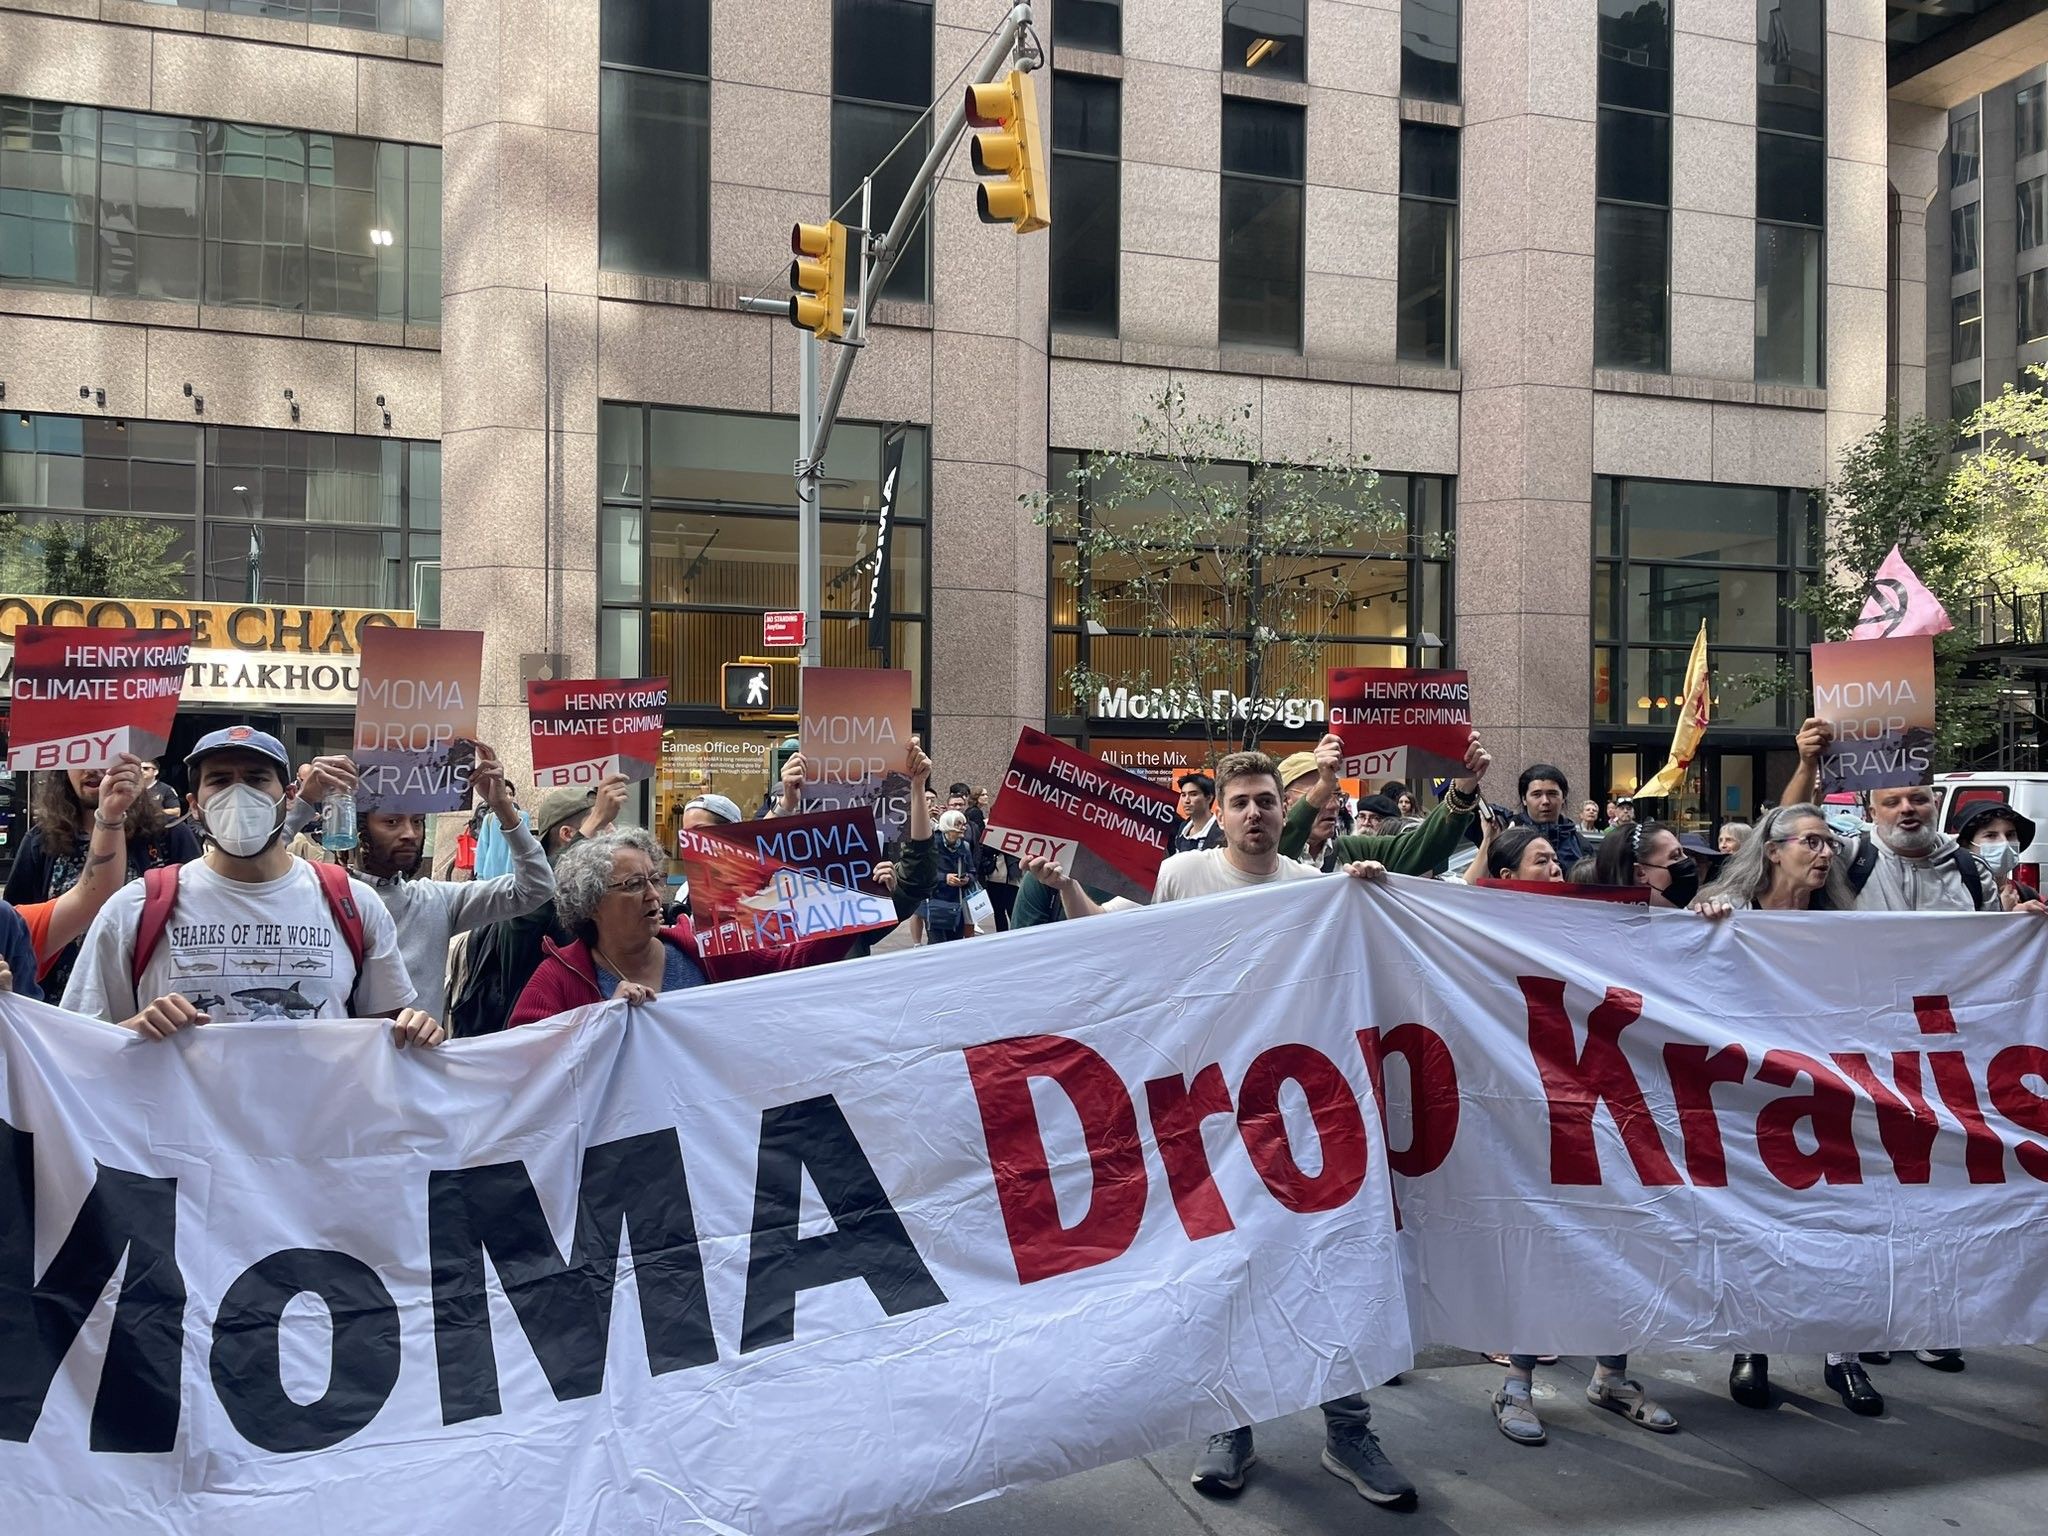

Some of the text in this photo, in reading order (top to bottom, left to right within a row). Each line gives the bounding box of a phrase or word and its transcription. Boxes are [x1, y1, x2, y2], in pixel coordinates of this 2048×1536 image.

[766, 615, 798, 623] NO STANDING
[65, 644, 190, 668] HENRY KRAVIS
[14, 674, 183, 701] CLIMATE CRIMINAL
[361, 678, 464, 710] MOMA
[565, 689, 668, 711] HENRY KRAVIS
[1364, 682, 1469, 700] HENRY KRAVIS
[1816, 679, 1917, 710] MOMA
[1098, 687, 1325, 729] MoMA Design
[1330, 707, 1471, 725] CLIMATE CRIMINAL
[357, 721, 454, 753] DROP
[531, 714, 663, 736] CLIMATE CRIMINAL
[803, 715, 897, 745] MOMA
[35, 733, 117, 769] BOY
[662, 741, 702, 753] Eames
[704, 741, 740, 754] Office
[1101, 750, 1188, 766] All in the Mix
[552, 760, 609, 787] BOY
[802, 756, 886, 786] DROP
[1346, 751, 1398, 778] BOY
[1820, 747, 1930, 779] KRAVIS
[356, 765, 472, 795] KRAVIS
[1049, 756, 1175, 824] HENRY KRAVIS
[1004, 769, 1166, 850] CLIMATE CRIMINAL
[756, 823, 869, 866] MOMA
[1001, 832, 1067, 862] BOY
[774, 860, 871, 902] DROP
[172, 924, 332, 948] SHARKS OF THE WORLD
[752, 897, 882, 949] KRAVIS
[0, 974, 2048, 1454] MoMA Drop Kravis
